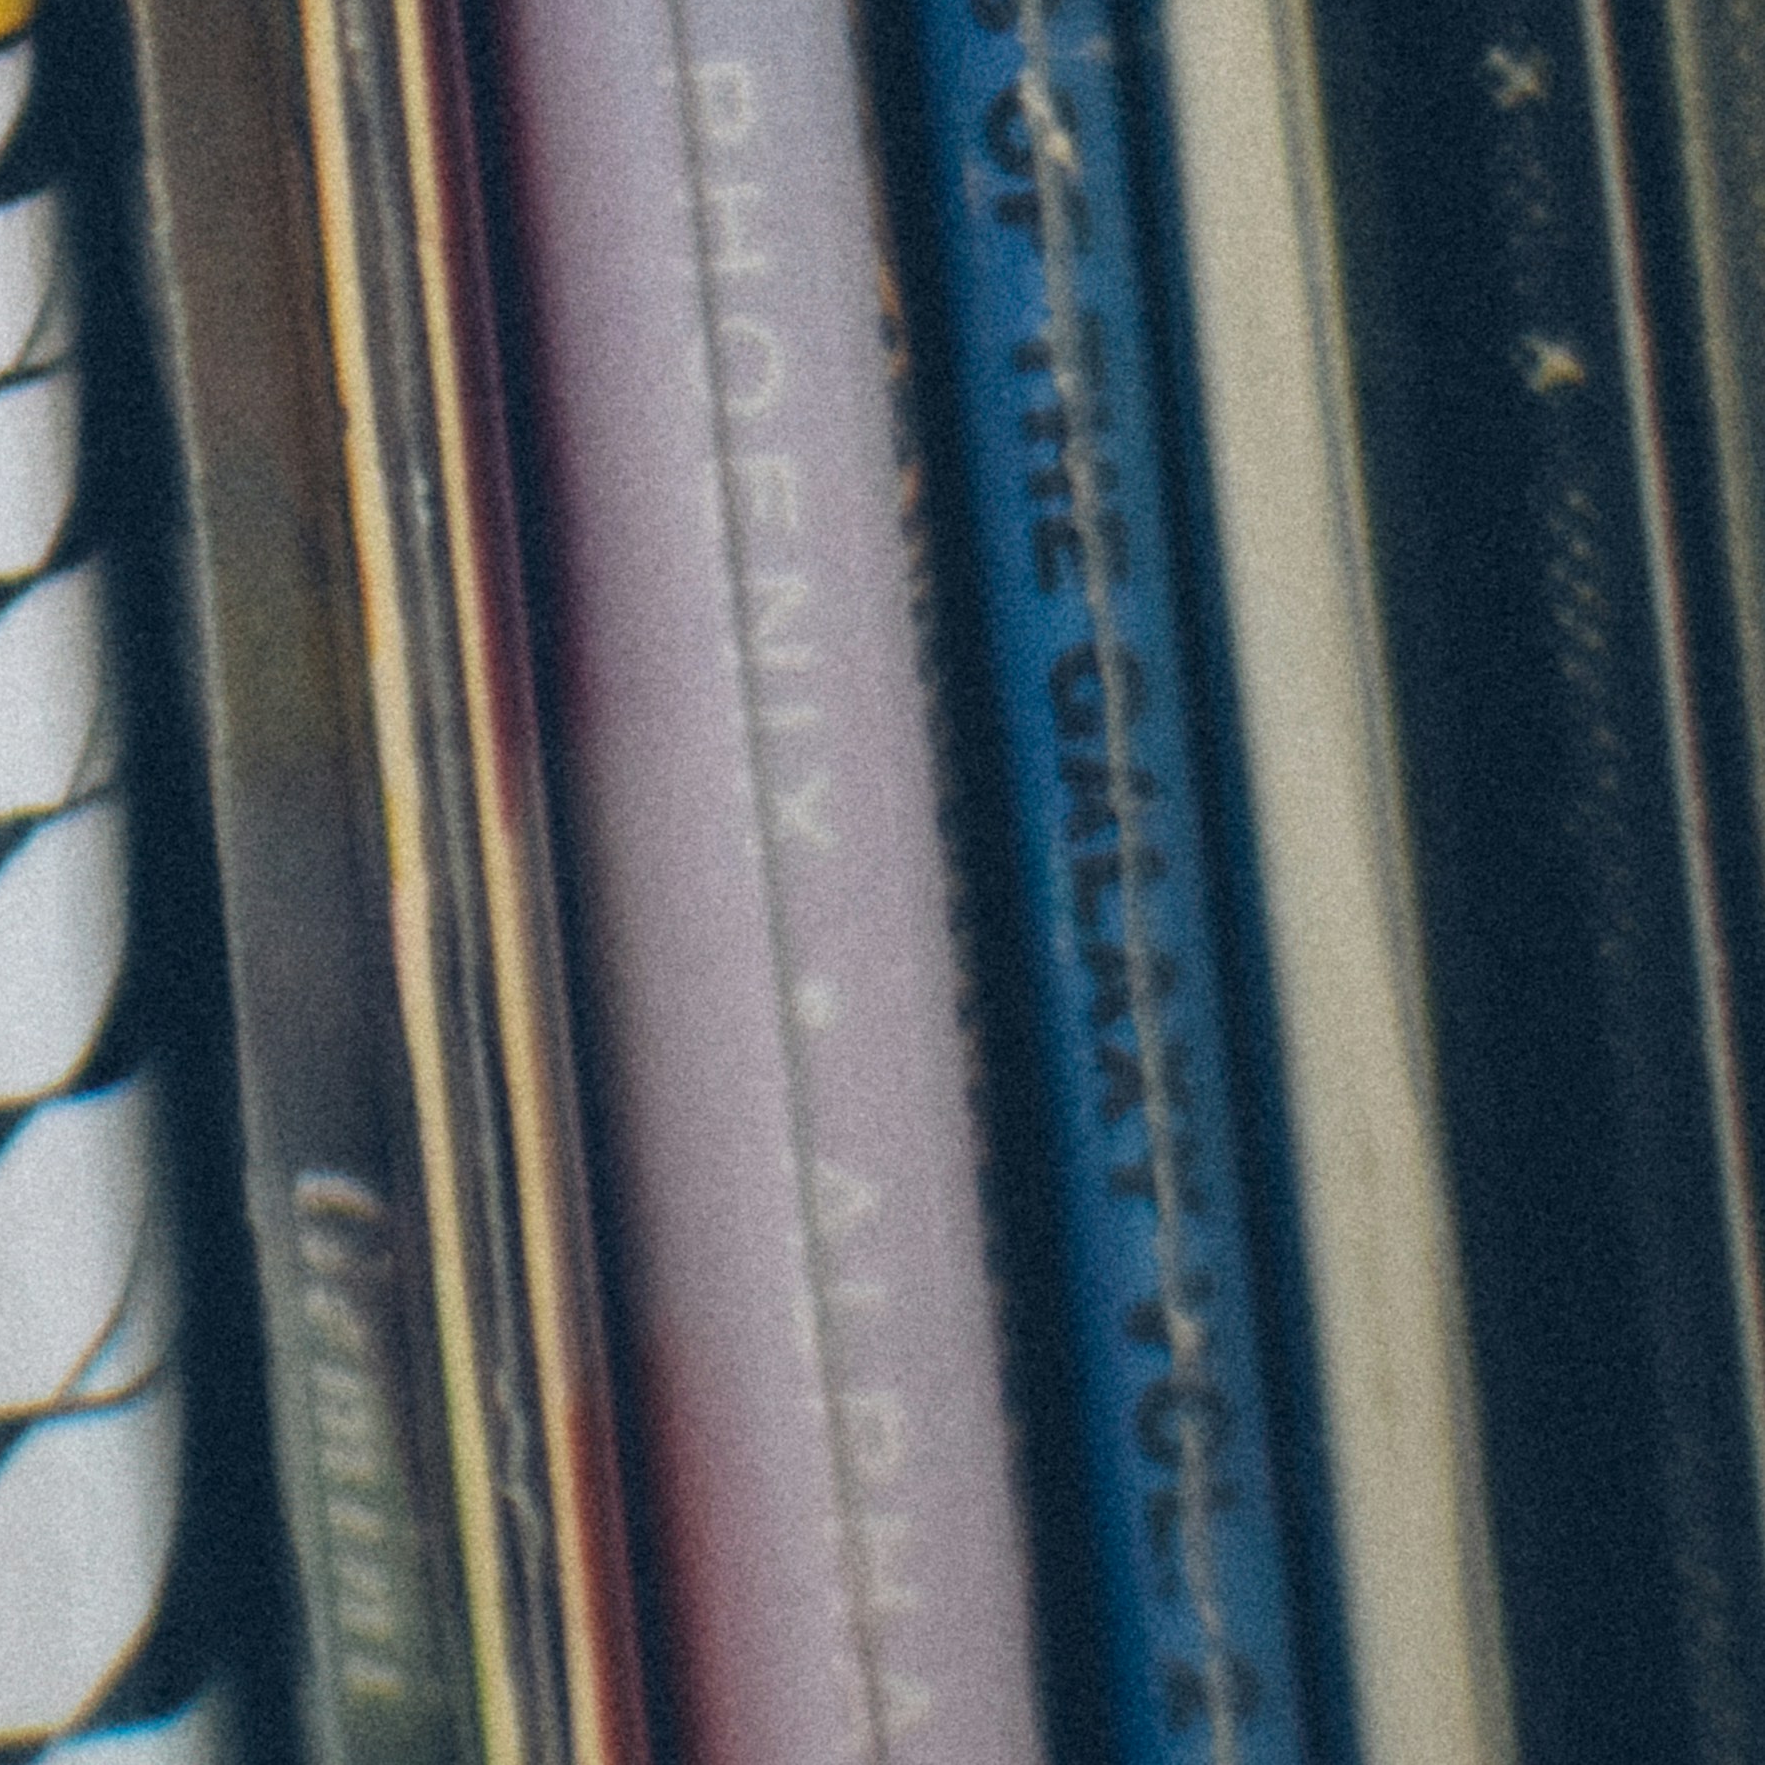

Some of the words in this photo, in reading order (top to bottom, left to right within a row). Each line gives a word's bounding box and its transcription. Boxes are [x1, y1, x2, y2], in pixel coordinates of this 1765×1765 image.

[984, 83, 1095, 256] OF
[667, 58, 839, 851] PHOENIX
[1011, 308, 1133, 596] THE
[1047, 640, 1210, 1218] GALAXY
